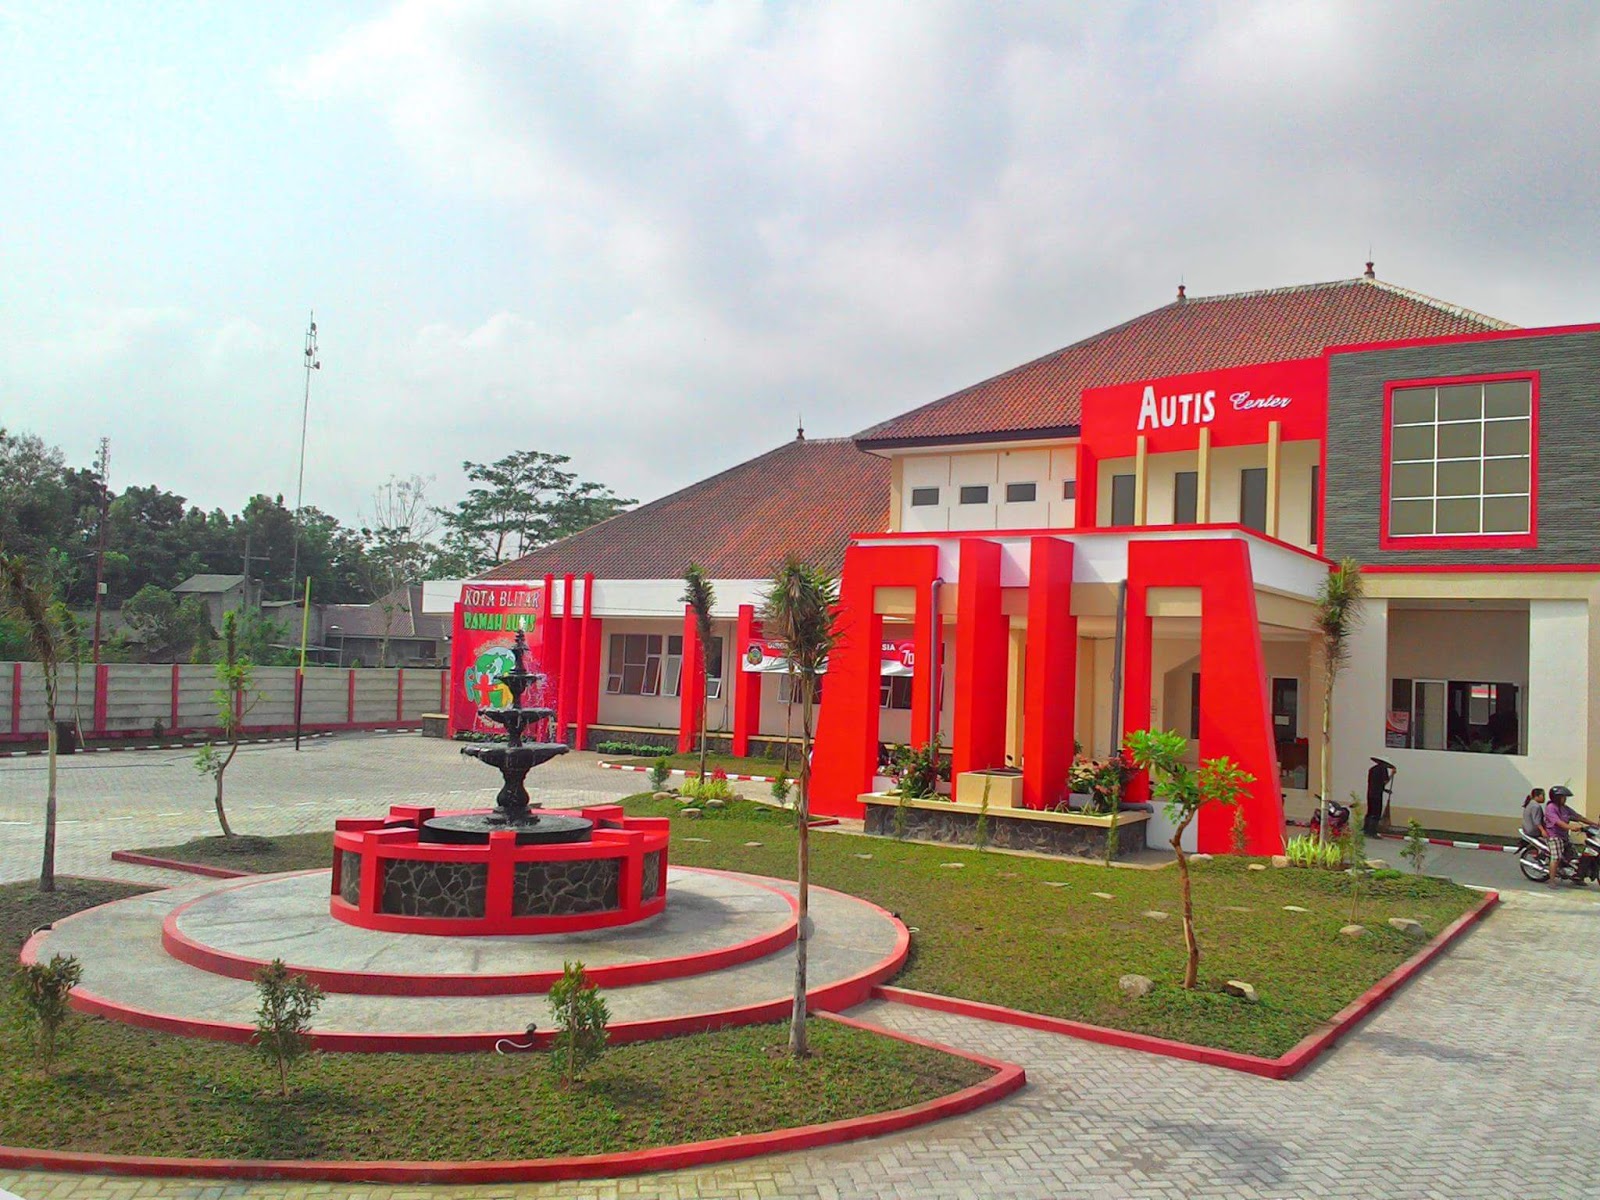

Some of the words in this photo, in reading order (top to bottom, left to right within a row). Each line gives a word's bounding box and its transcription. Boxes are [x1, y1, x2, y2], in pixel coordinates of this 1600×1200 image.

[1136, 385, 1216, 431] AUTIS
[1229, 390, 1292, 411] Center
[464, 589, 496, 607] KOTA
[500, 590, 541, 609] BLITAR
[463, 611, 503, 631] RAMAH
